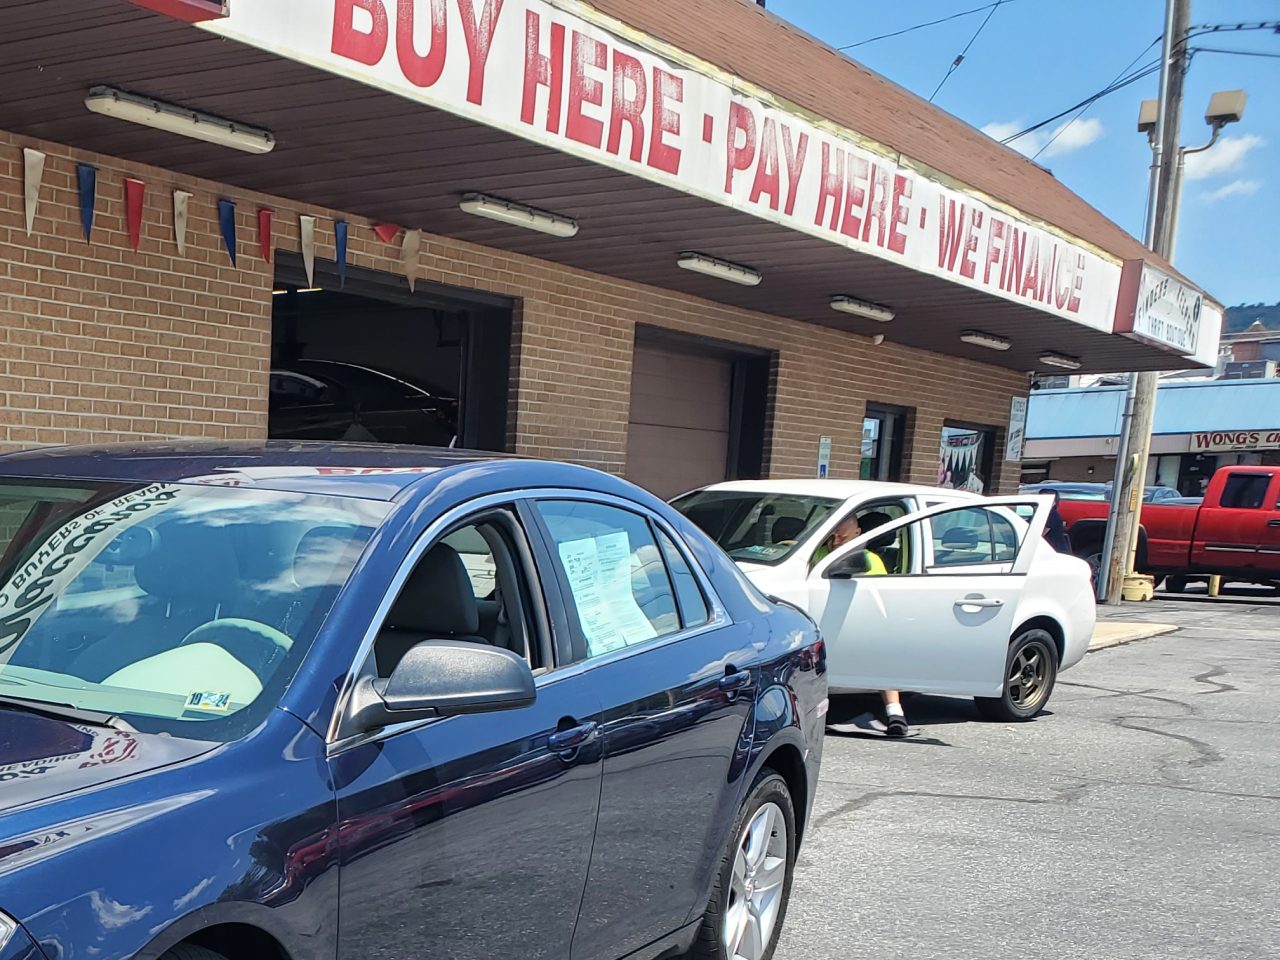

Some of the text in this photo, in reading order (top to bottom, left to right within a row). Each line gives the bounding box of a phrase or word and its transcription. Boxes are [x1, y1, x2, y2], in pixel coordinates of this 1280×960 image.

[330, 0, 1086, 313] BUY HERE PAY HERE WE FINANCE
[1195, 431, 1261, 449] WONG'S
[215, 694, 230, 707] 24
